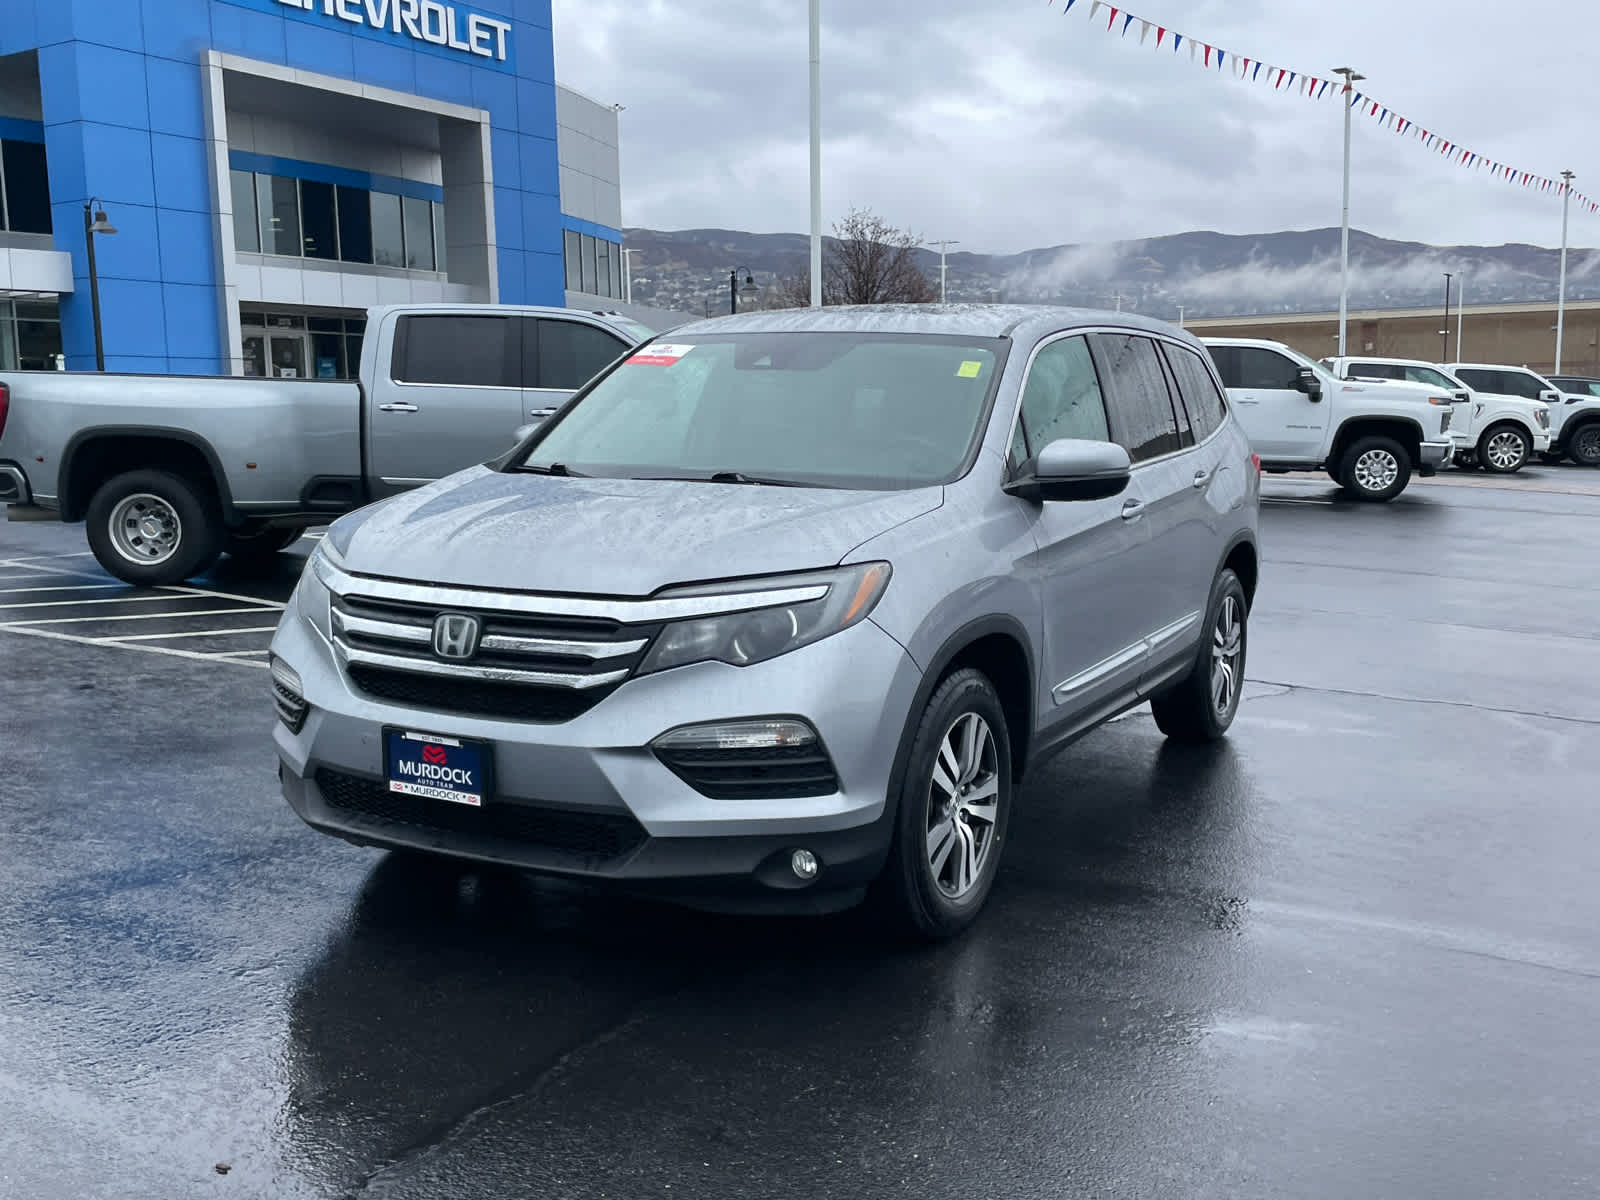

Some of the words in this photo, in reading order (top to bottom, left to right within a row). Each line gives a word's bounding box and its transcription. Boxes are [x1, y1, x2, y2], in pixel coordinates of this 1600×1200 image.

[277, 0, 512, 61] EVROLET
[399, 760, 473, 785] MURDOCK
[418, 778, 434, 786] AUTO
[411, 785, 460, 801] MURDOCK
